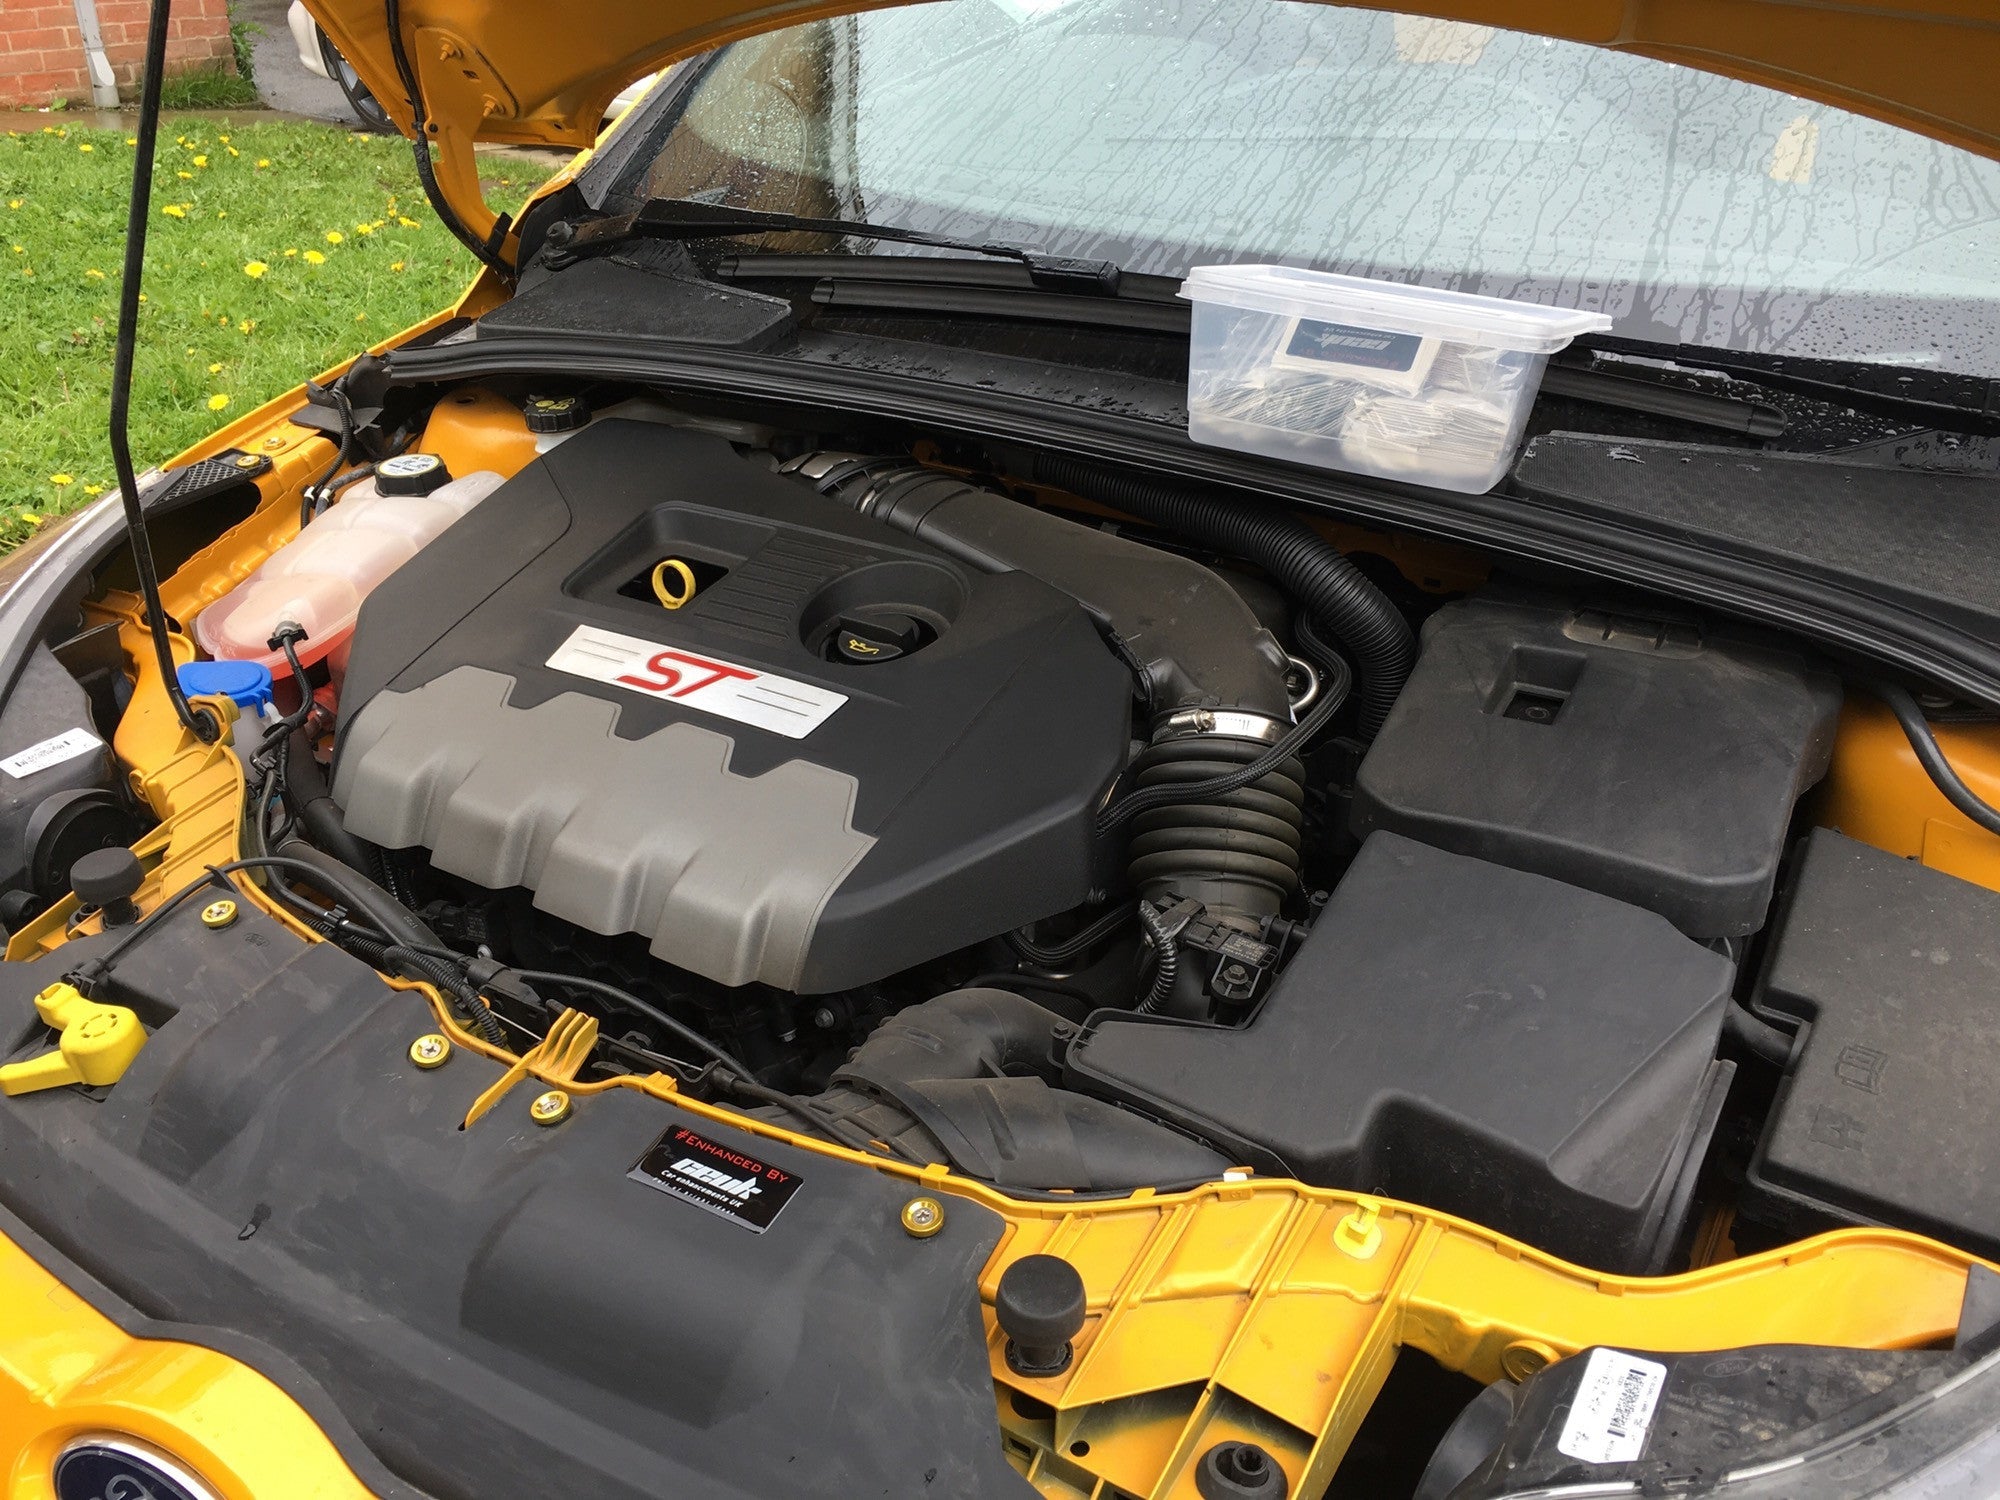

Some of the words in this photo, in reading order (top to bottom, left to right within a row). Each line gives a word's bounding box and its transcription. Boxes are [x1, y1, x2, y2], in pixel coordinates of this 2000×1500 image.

[615, 651, 760, 698] ST
[660, 1169, 676, 1179] Car
[676, 1176, 729, 1202] enhancements
[730, 1199, 744, 1208] UK
